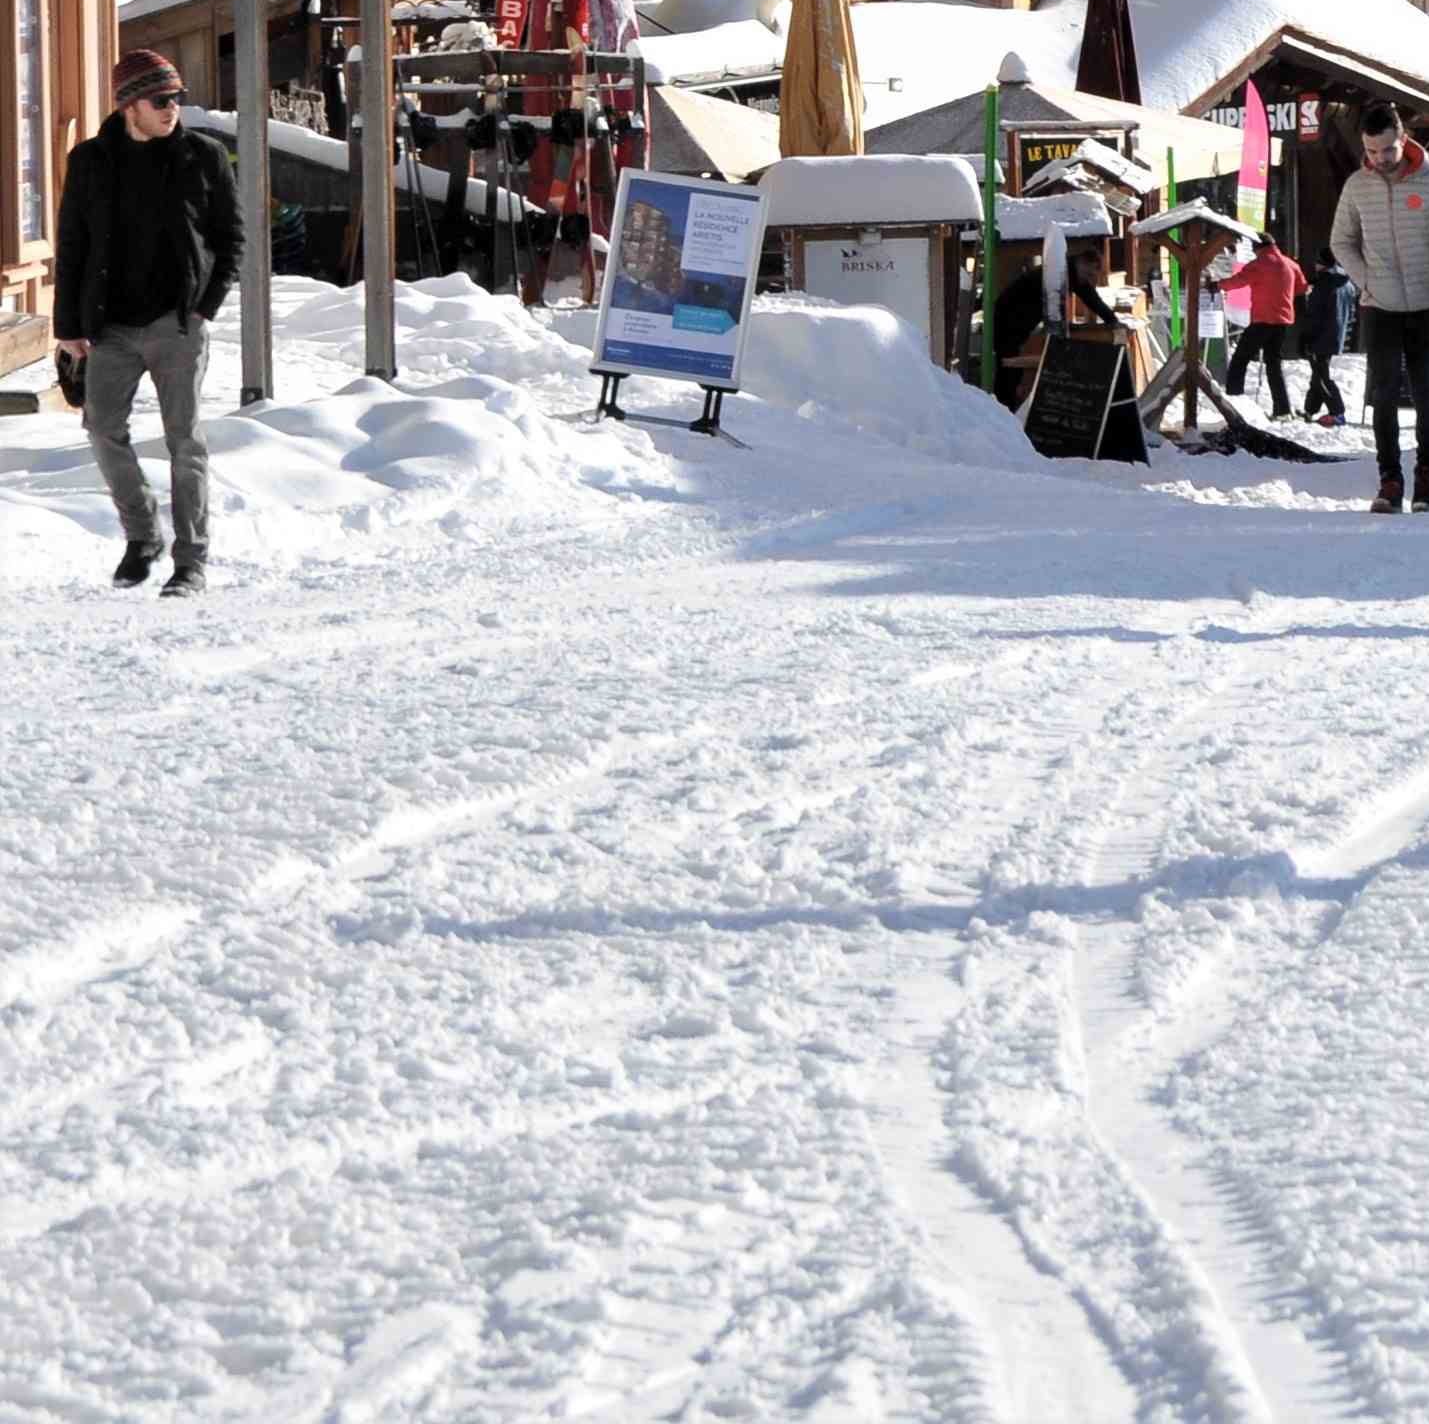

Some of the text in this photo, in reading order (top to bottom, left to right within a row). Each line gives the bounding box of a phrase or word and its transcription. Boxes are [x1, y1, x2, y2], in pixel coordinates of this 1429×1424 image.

[1266, 102, 1297, 131] SKI
[1028, 144, 1080, 161] LE TAVA
[841, 260, 895, 273] BRISKA
